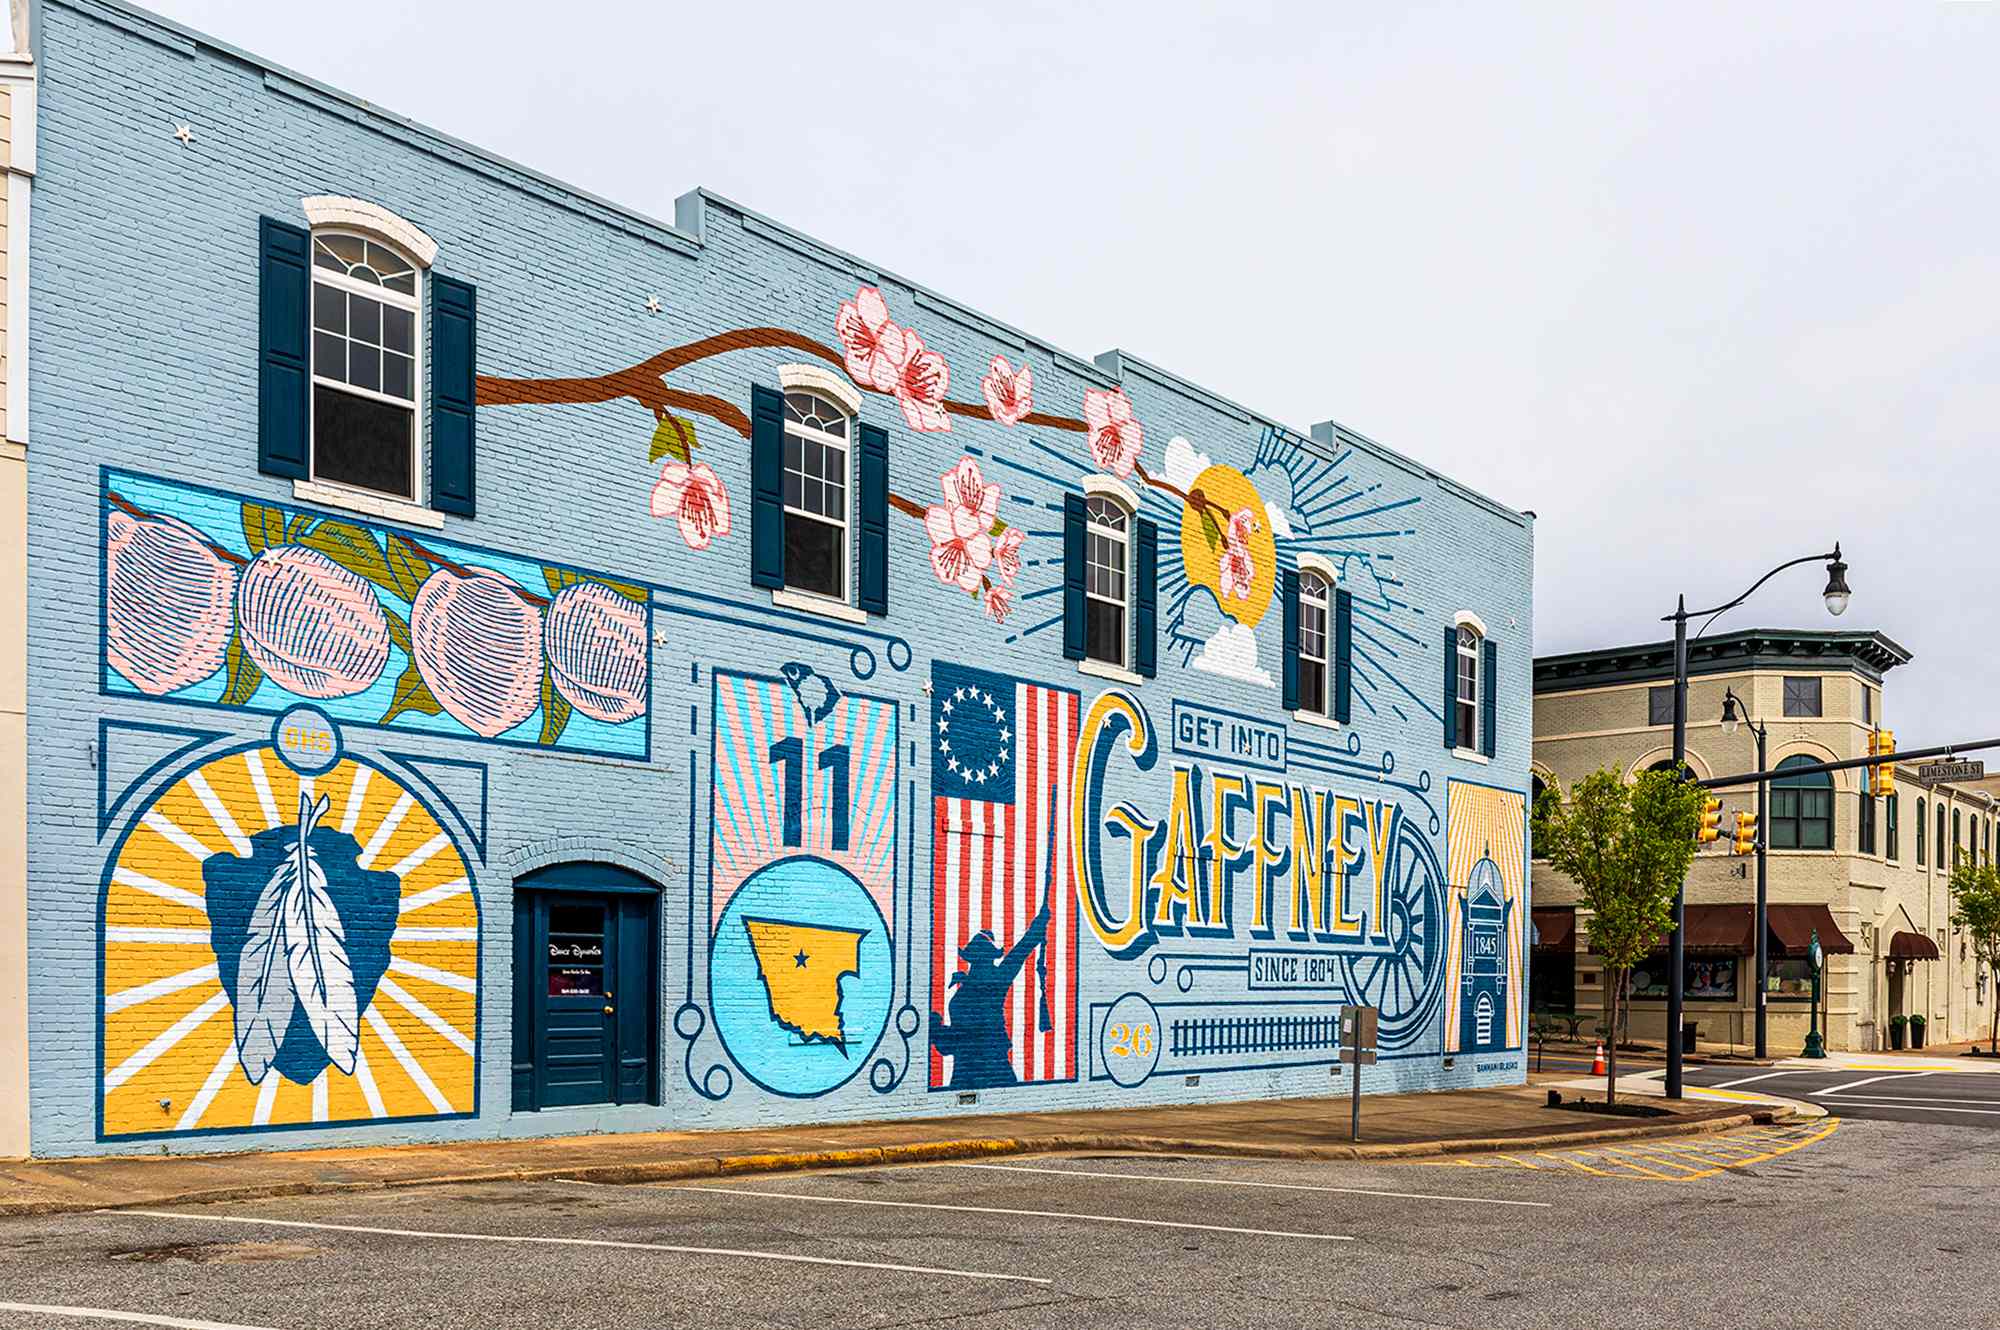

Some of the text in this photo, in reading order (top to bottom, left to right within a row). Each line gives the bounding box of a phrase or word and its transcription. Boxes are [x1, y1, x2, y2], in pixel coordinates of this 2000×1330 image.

[284, 726, 331, 753] GHS
[1180, 713, 1279, 761] GET INTO
[1921, 763, 1981, 778] LIMESTONE ST
[769, 736, 850, 851] 11
[1071, 687, 1402, 960] GAFFNEY
[1475, 936, 1497, 955] 1845
[1255, 956, 1335, 982] SINCE 1804
[1110, 1023, 1153, 1057] 26
